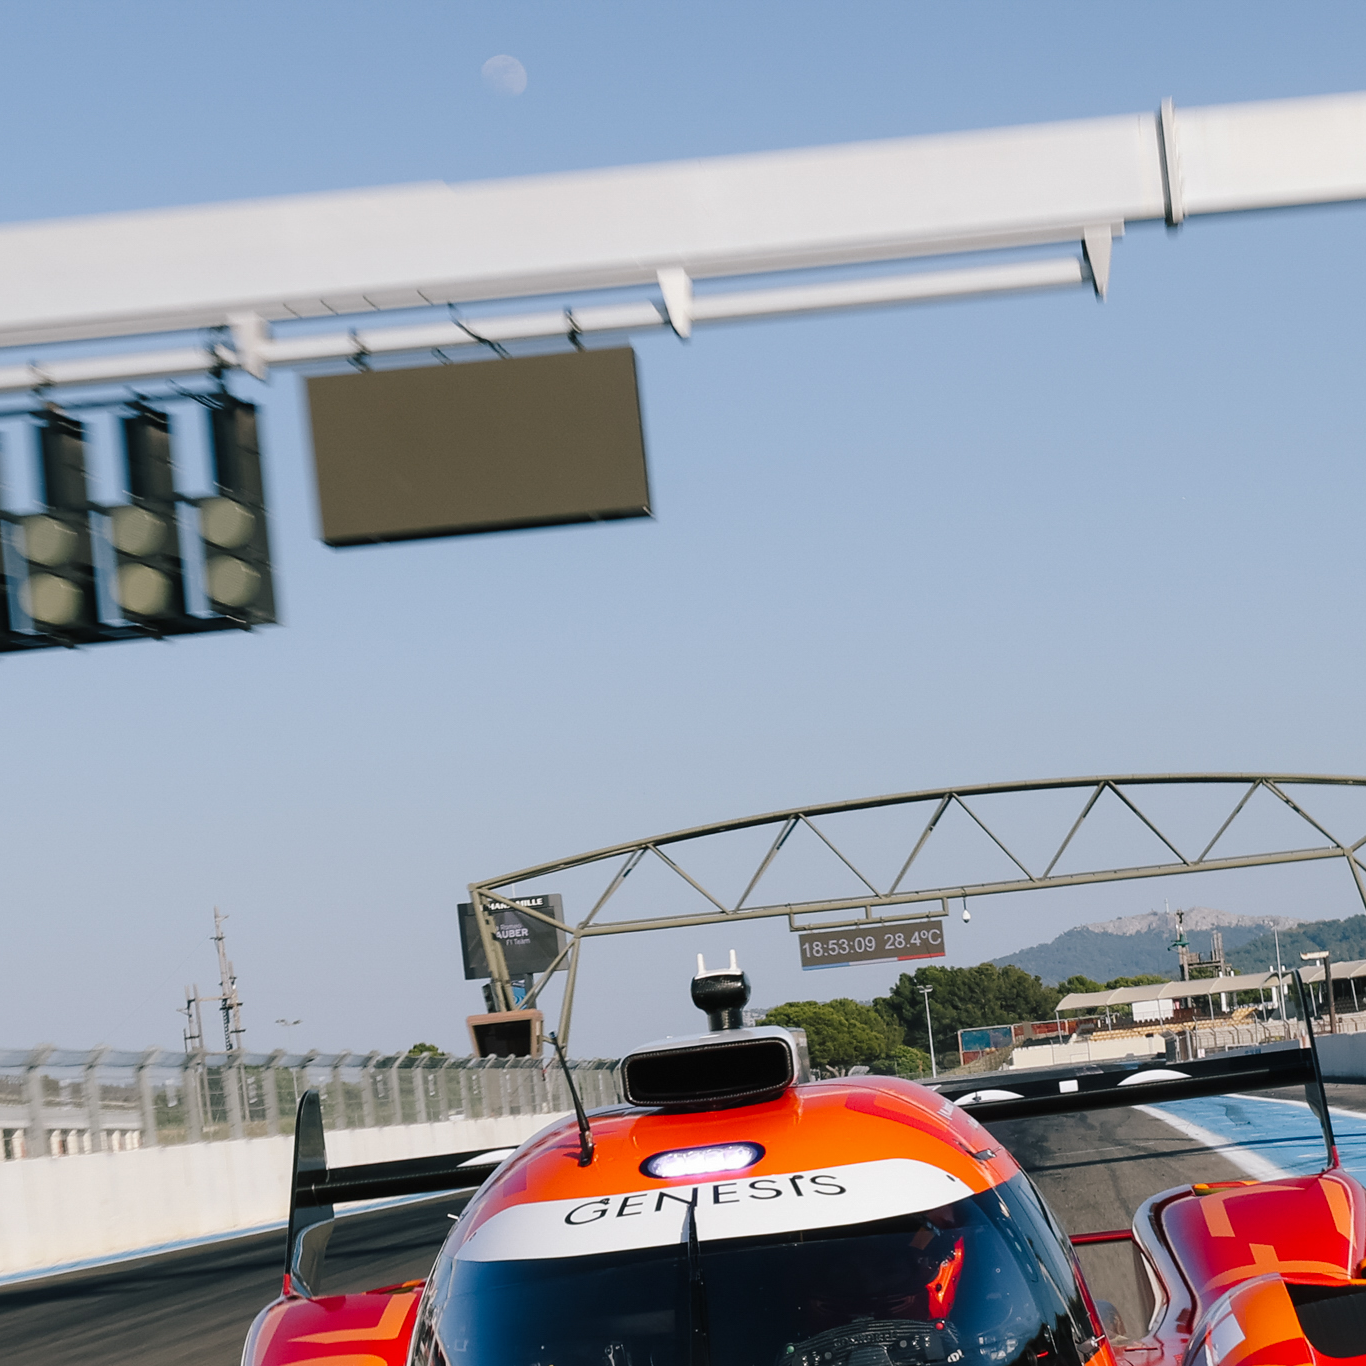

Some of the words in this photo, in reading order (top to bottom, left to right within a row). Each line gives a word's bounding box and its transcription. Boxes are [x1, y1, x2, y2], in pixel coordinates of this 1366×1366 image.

[496, 927, 529, 939] AUBER
[802, 936, 876, 958] 18:53:09
[564, 1174, 847, 1226] GENESIS
